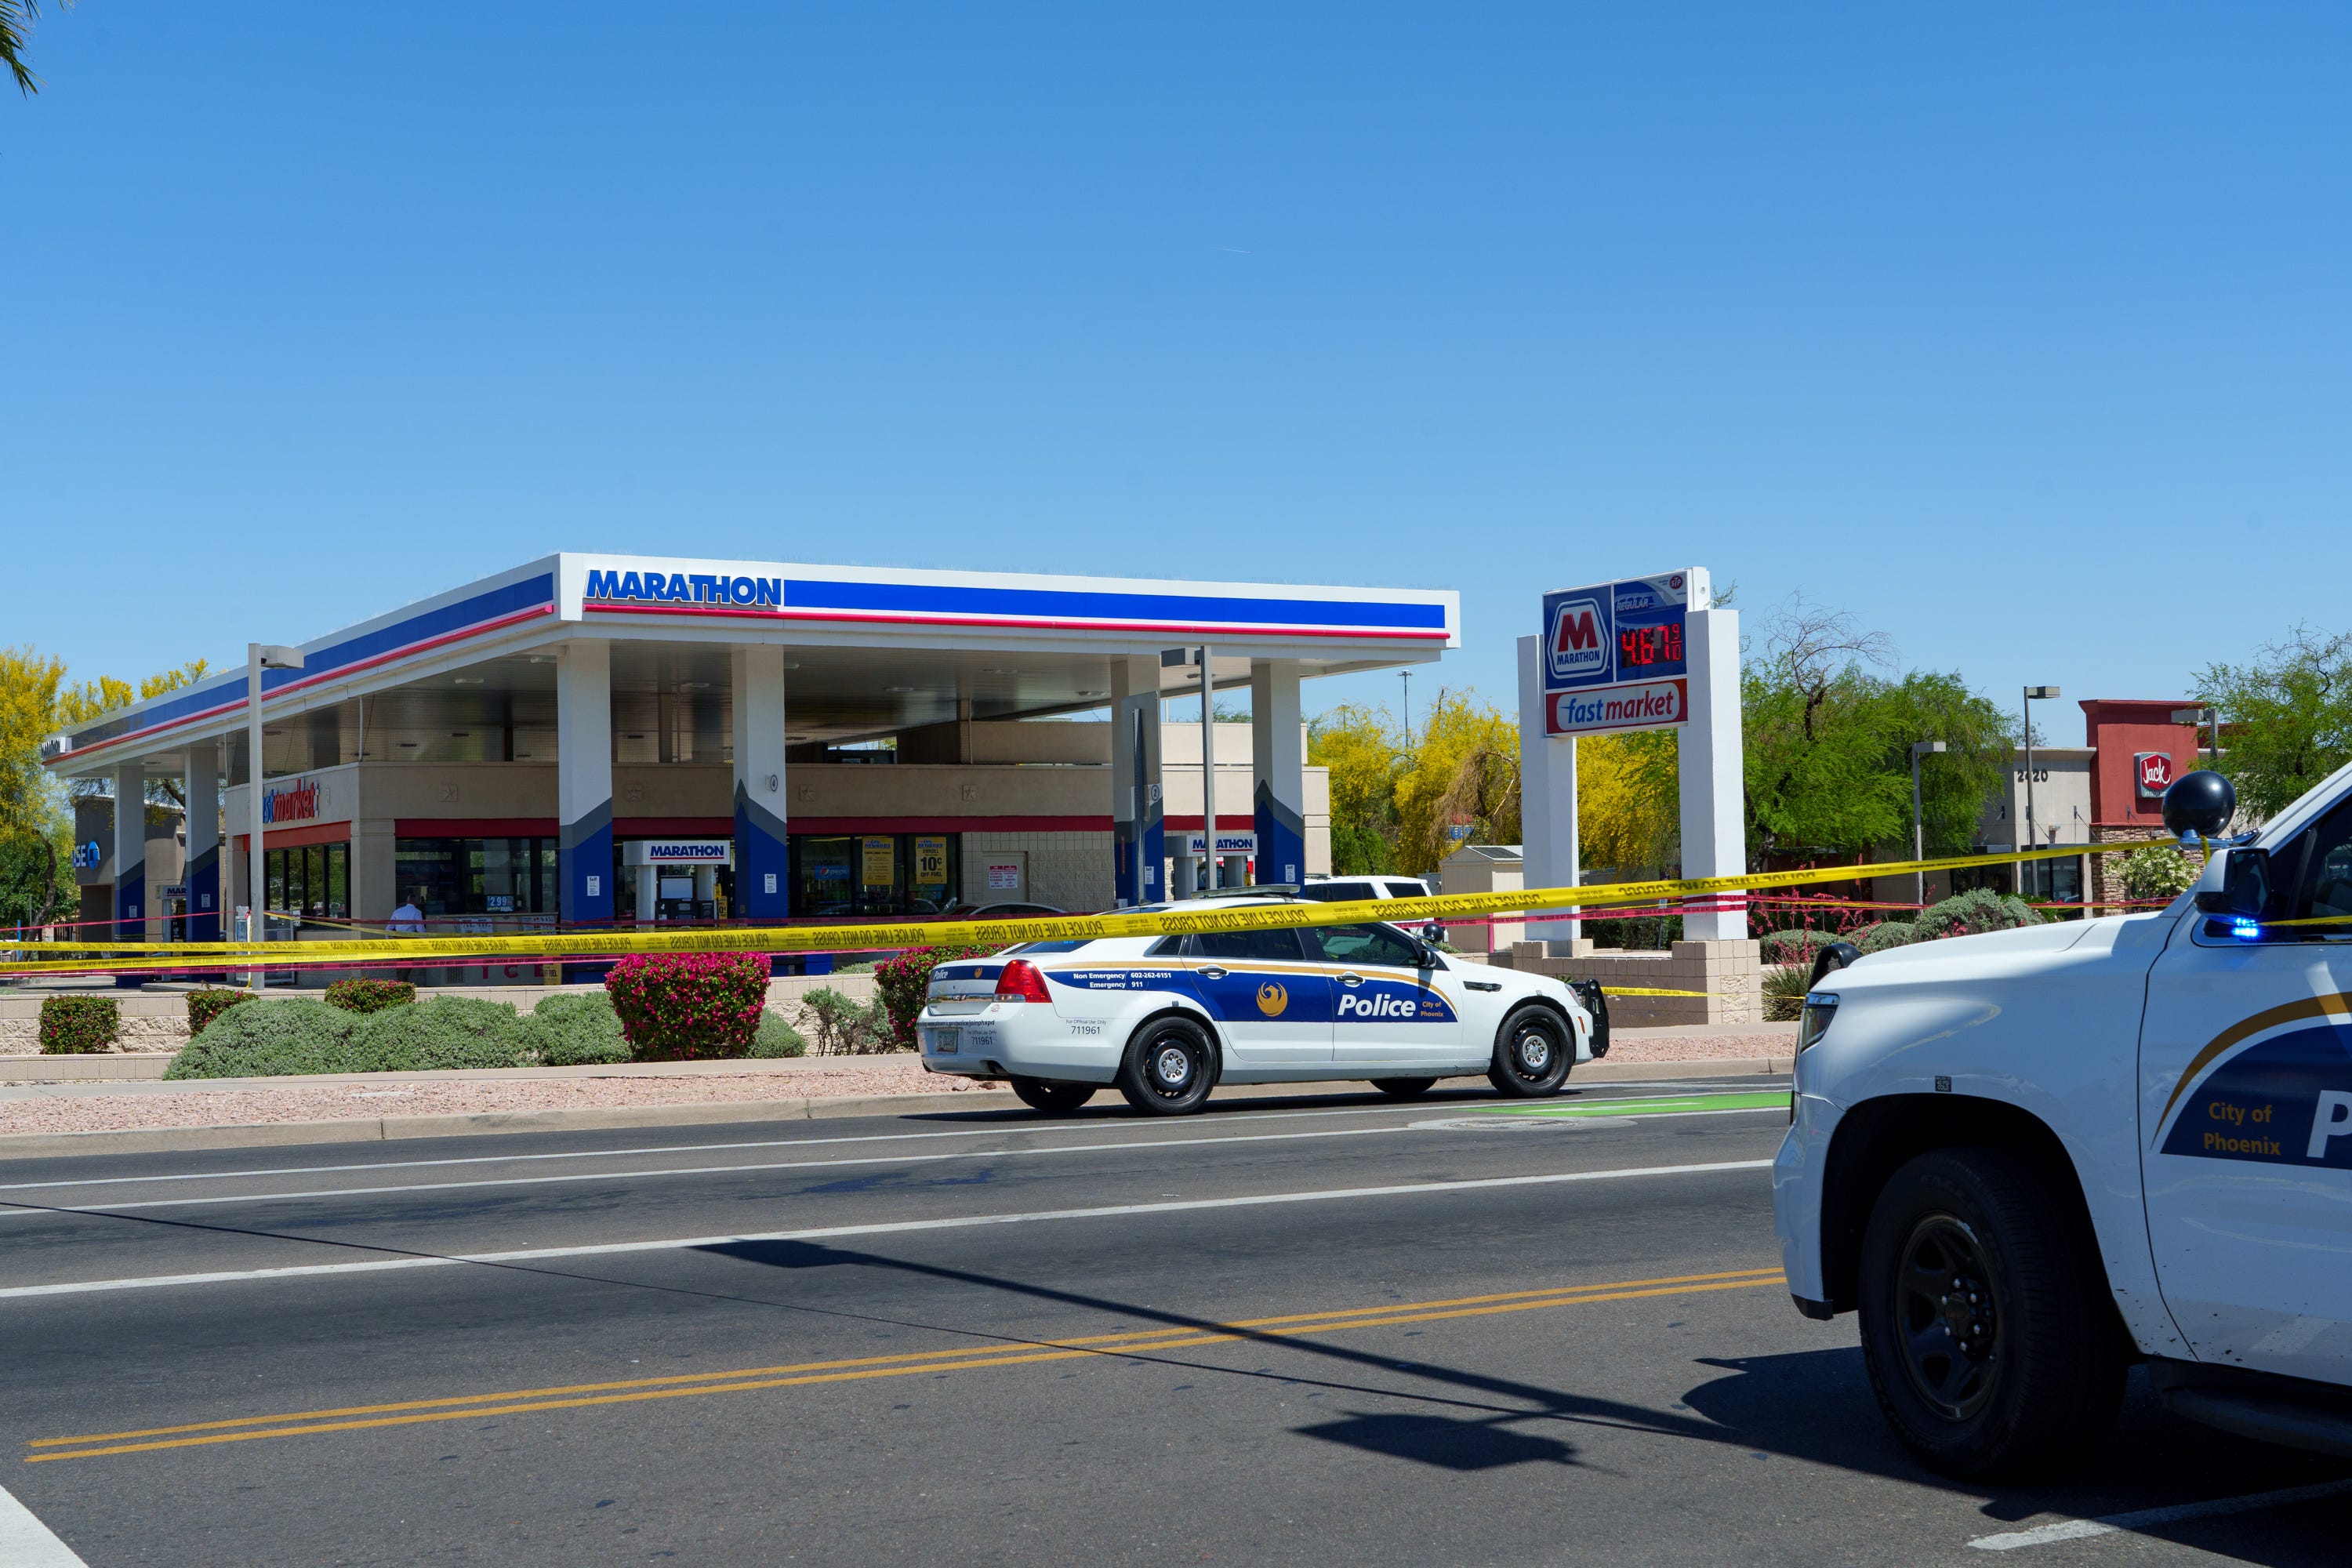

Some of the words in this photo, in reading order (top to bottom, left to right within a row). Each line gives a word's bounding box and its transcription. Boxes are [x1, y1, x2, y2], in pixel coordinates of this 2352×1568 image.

[586, 570, 782, 605] MARATHON
[1671, 577, 1682, 588] STP
[1616, 597, 1649, 612] REGULAR
[1558, 611, 1598, 652] M
[1557, 650, 1600, 666] MARATHON
[2143, 758, 2171, 784] Jack
[650, 845, 724, 856] MARATHON
[1192, 838, 1253, 848] MATHON
[490, 896, 507, 906] 2.99
[1338, 993, 1417, 1017] Police
[1071, 1025, 1101, 1035] 711961
[971, 1036, 993, 1045] 711961
[2209, 1102, 2245, 1126] City
[2252, 1105, 2272, 1123] of
[2204, 1132, 2281, 1156] Phoenix
